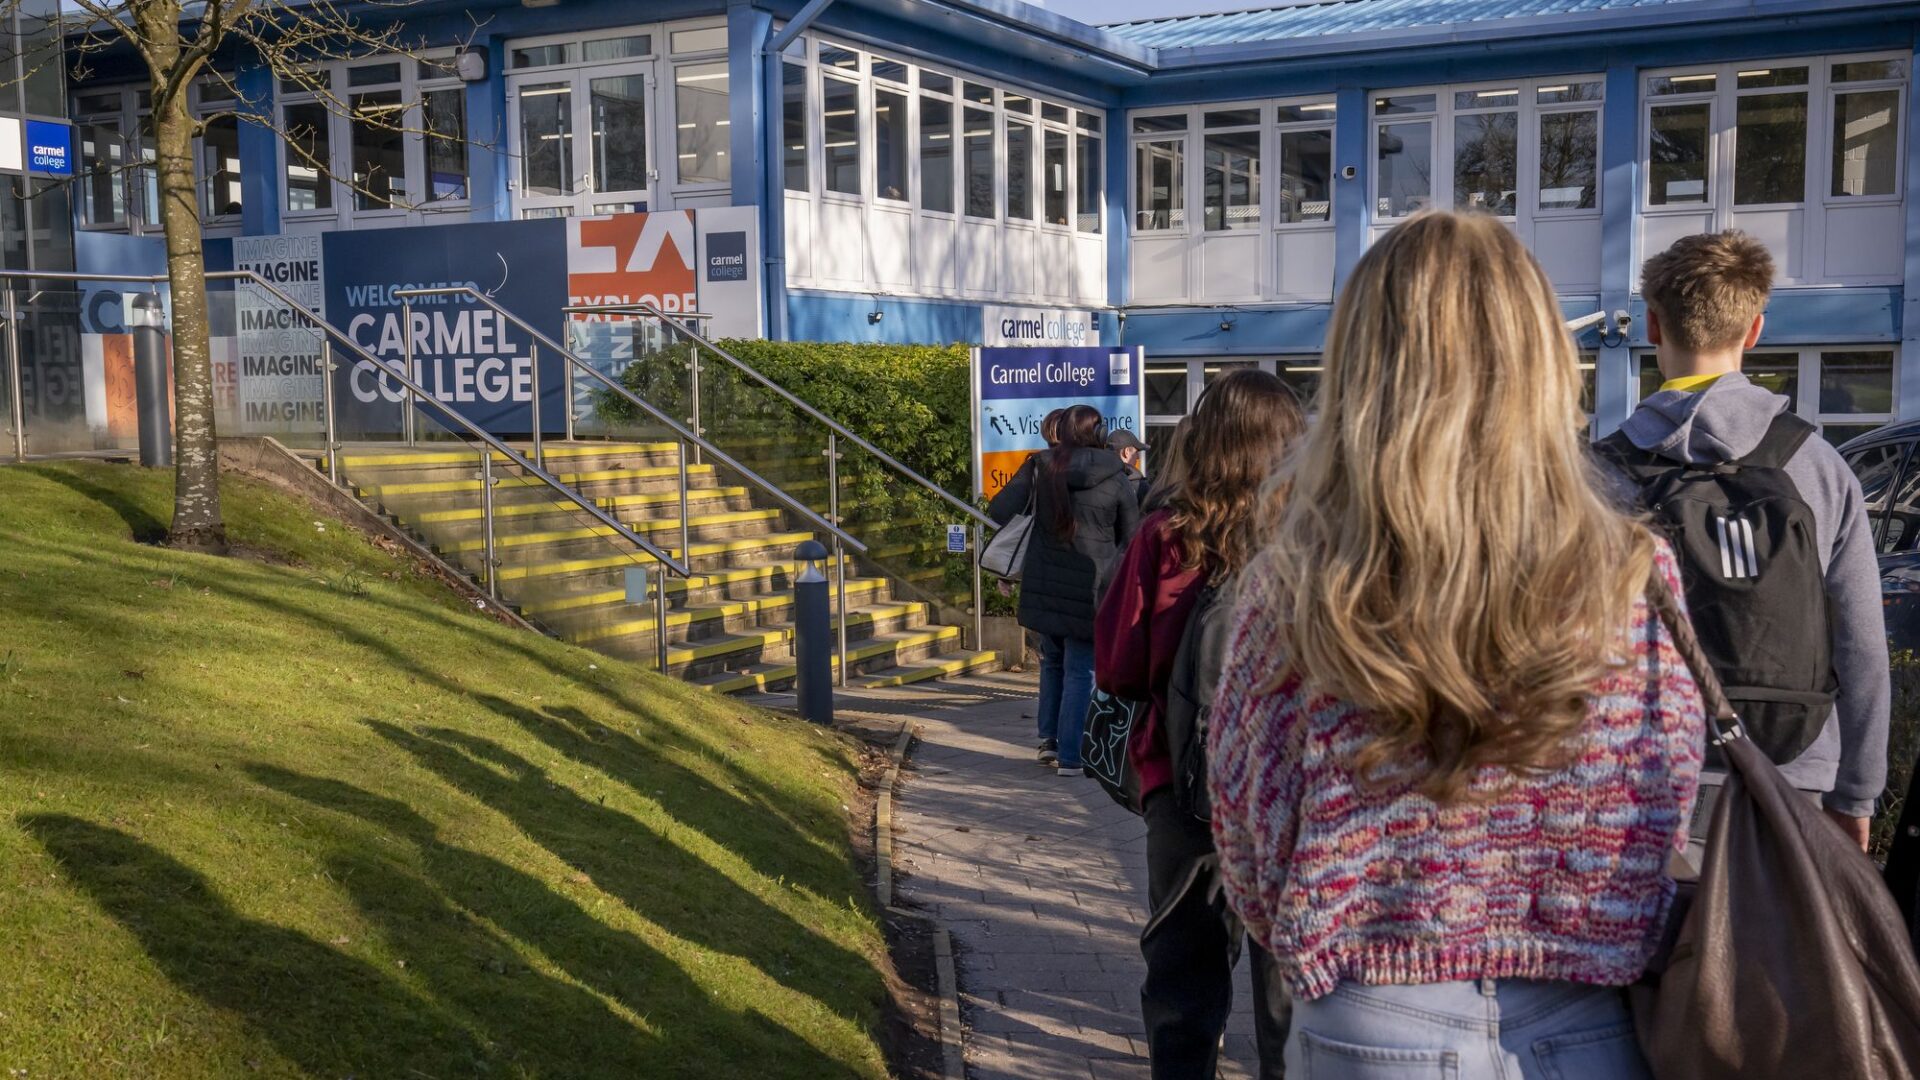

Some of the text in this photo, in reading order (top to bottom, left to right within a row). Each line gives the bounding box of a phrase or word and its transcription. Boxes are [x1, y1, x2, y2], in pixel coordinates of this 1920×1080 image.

[33, 145, 65, 157] carmel
[34, 156, 65, 169] college
[237, 236, 319, 262] IMAGINE
[711, 253, 743, 266] carmel
[239, 260, 319, 284] IMAGINE
[711, 265, 743, 278] college
[346, 280, 480, 307] WELCOME TO
[241, 308, 321, 331] IMAGINE
[1001, 312, 1085, 347] carmel college
[348, 309, 517, 356] CARMEL
[243, 354, 323, 377] IMAGINE
[990, 362, 1041, 384] Carmel
[1045, 362, 1096, 387] College
[350, 357, 532, 403] COLLEGE
[246, 401, 325, 422] IMAGINE
